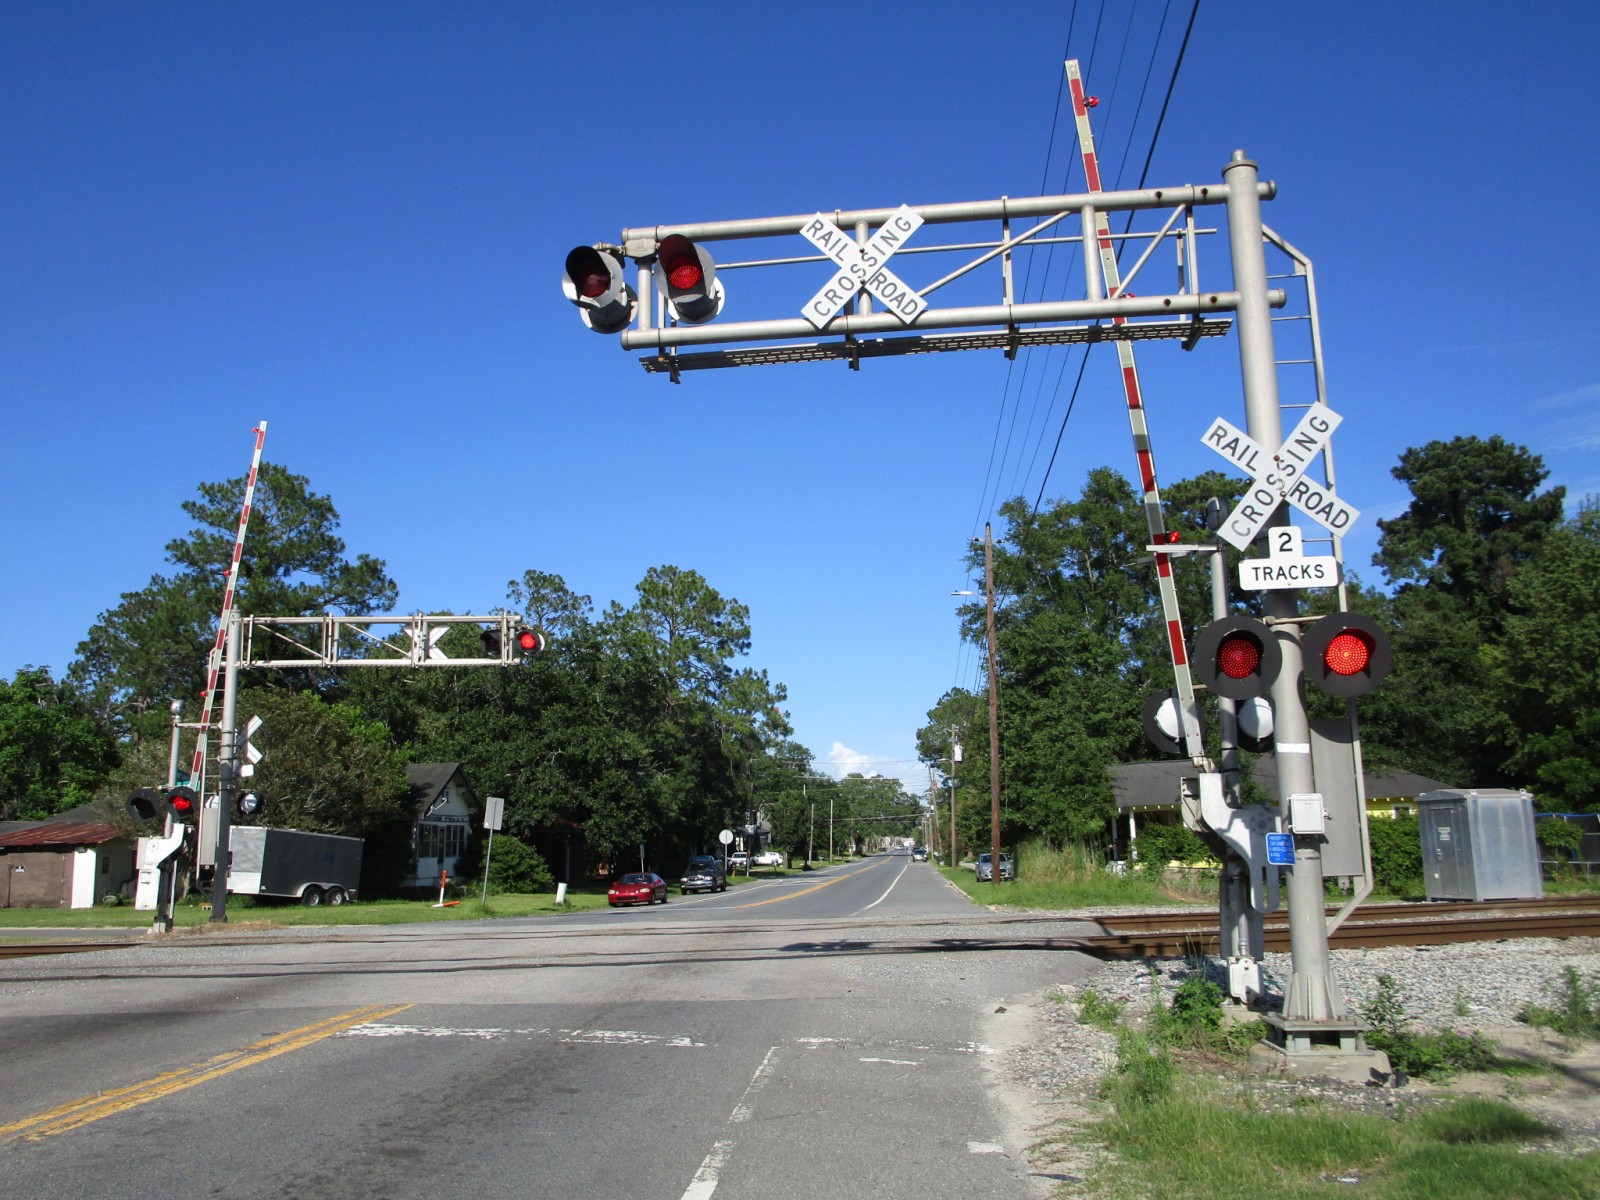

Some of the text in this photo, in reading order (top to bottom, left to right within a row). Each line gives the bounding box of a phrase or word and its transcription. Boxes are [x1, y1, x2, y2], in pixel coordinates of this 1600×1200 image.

[806, 219, 918, 316] RAIL ROAD
[813, 216, 912, 317] CROSSING
[1208, 424, 1350, 529] RAIL ROAD
[1231, 416, 1329, 538] CROSSING
[1252, 563, 1325, 582] TRACKS
[1278, 532, 1293, 553] 2
